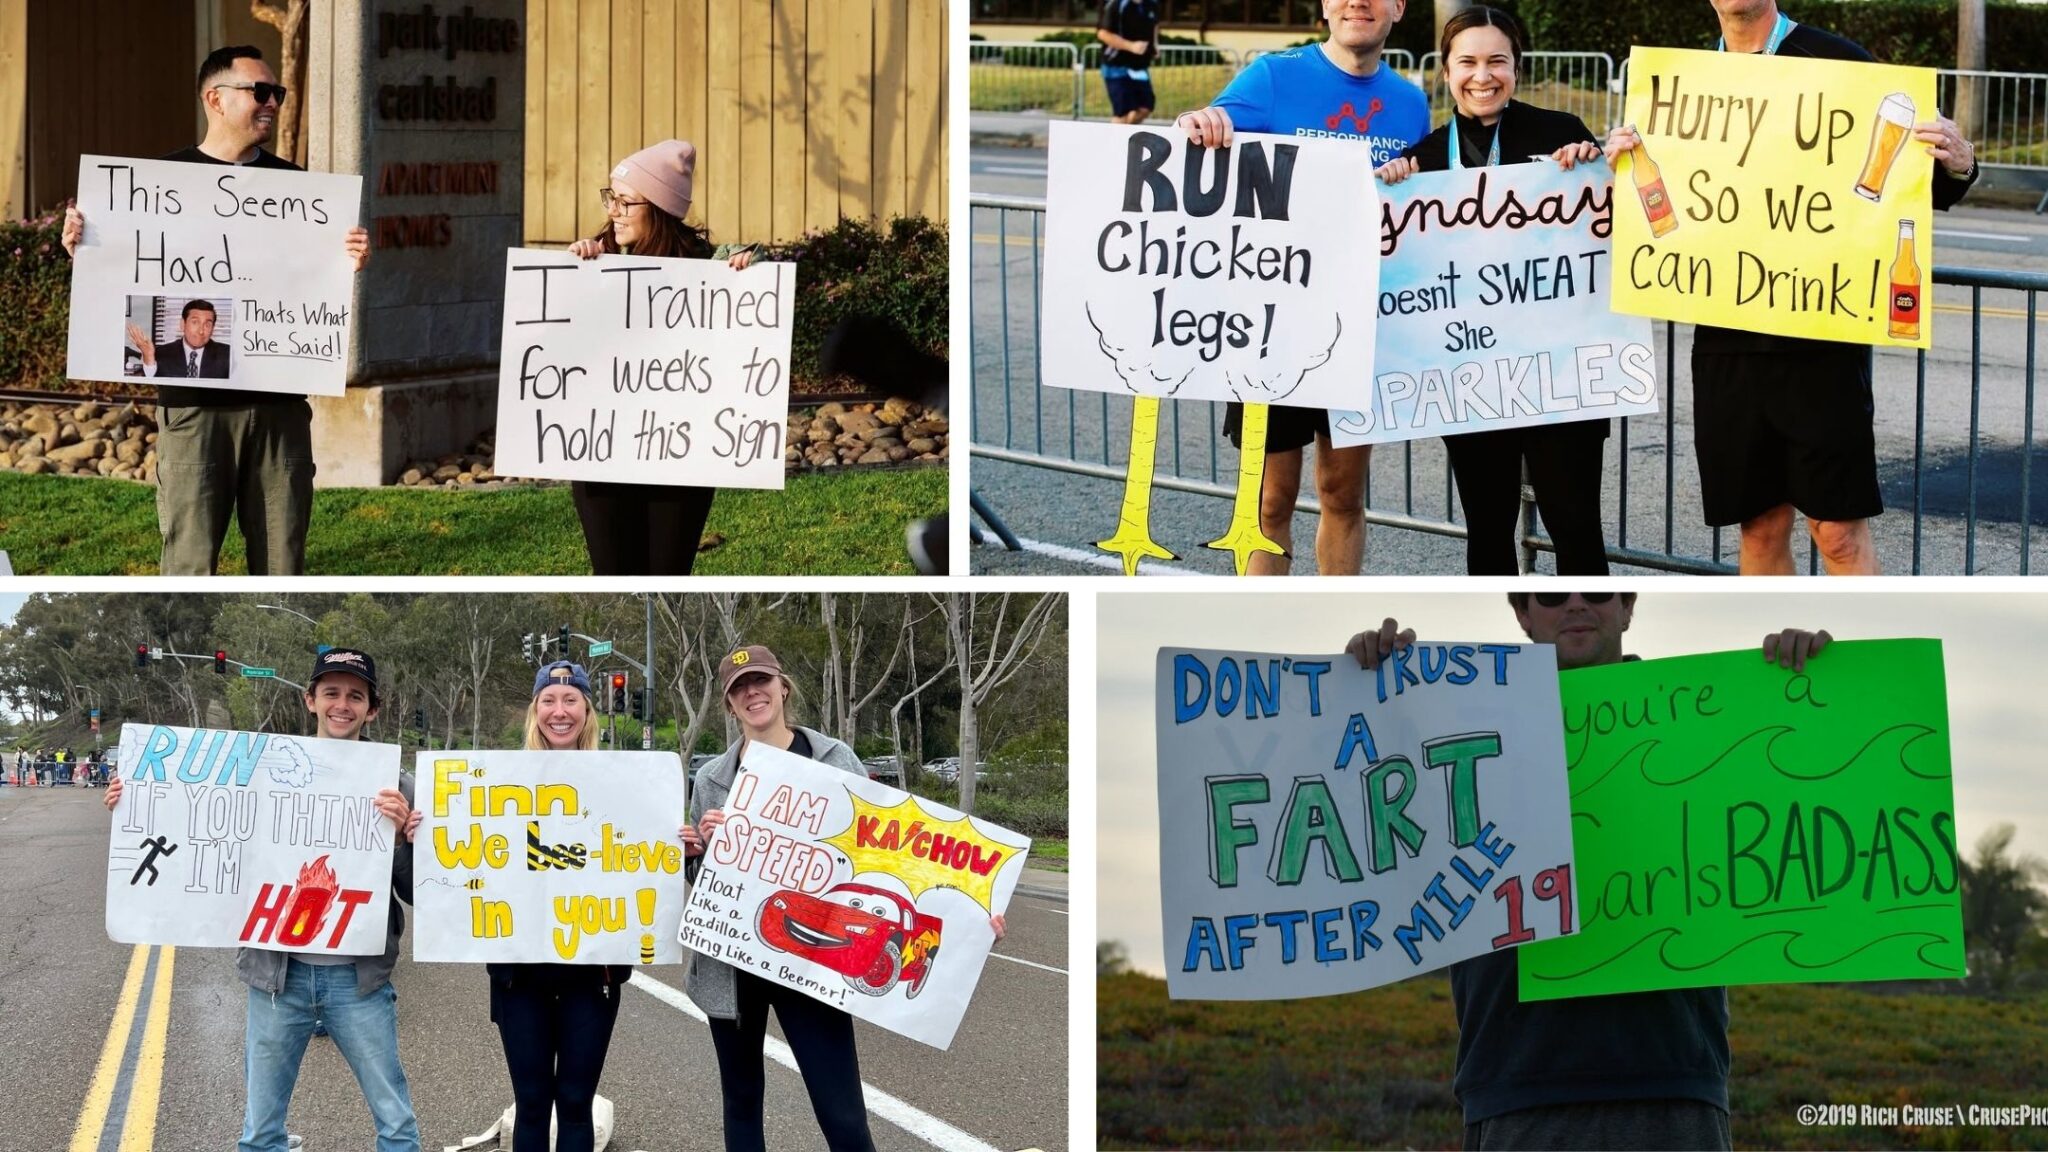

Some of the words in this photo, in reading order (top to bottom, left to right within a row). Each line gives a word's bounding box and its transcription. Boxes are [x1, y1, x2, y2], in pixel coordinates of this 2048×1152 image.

[378, 4, 441, 59] park
[1646, 74, 1769, 167] Hurry
[1795, 92, 1854, 165] Up
[97, 164, 182, 215] This
[214, 174, 329, 225] Seems
[377, 160, 500, 197] APARTMENT
[1121, 131, 1300, 221] RUN
[1686, 168, 1740, 224] So
[376, 213, 451, 248] HOMES
[1380, 171, 1614, 256] yndsay
[1097, 220, 1312, 288] Chicken
[1377, 261, 1461, 318] oesn't
[1478, 249, 1608, 306] SWEAT
[241, 299, 295, 324] Thats
[302, 302, 349, 327] What
[512, 264, 579, 326] I
[601, 264, 782, 331] Trained
[1736, 250, 1881, 322] Drink!
[243, 330, 279, 353] She
[288, 331, 342, 360] Said!
[1152, 287, 1276, 362] legs!
[1444, 320, 1497, 353] She
[519, 344, 587, 400] for
[612, 348, 713, 394] weeks
[742, 346, 782, 397] to
[536, 408, 616, 464] hold
[634, 409, 692, 461] this
[712, 407, 782, 467] Sign
[1174, 653, 1332, 725] DON'T
[1784, 673, 1829, 708] a
[132, 725, 269, 787] RUN
[1334, 712, 1379, 771] A
[121, 779, 173, 836] IF
[184, 783, 257, 842] YOU
[269, 791, 387, 852] THINK
[760, 784, 829, 835] AM
[1204, 731, 1502, 888] FART
[184, 838, 243, 895] I'M
[238, 883, 374, 949] HOT
[684, 909, 751, 942] Cadillac
[691, 892, 721, 913] Like
[729, 909, 744, 921] a
[1182, 900, 1383, 973] AFTER
[1393, 821, 1516, 965] MILE
[1492, 863, 1572, 951] 19
[680, 926, 722, 958] Sting
[726, 944, 754, 966] Like
[760, 960, 772, 972] a
